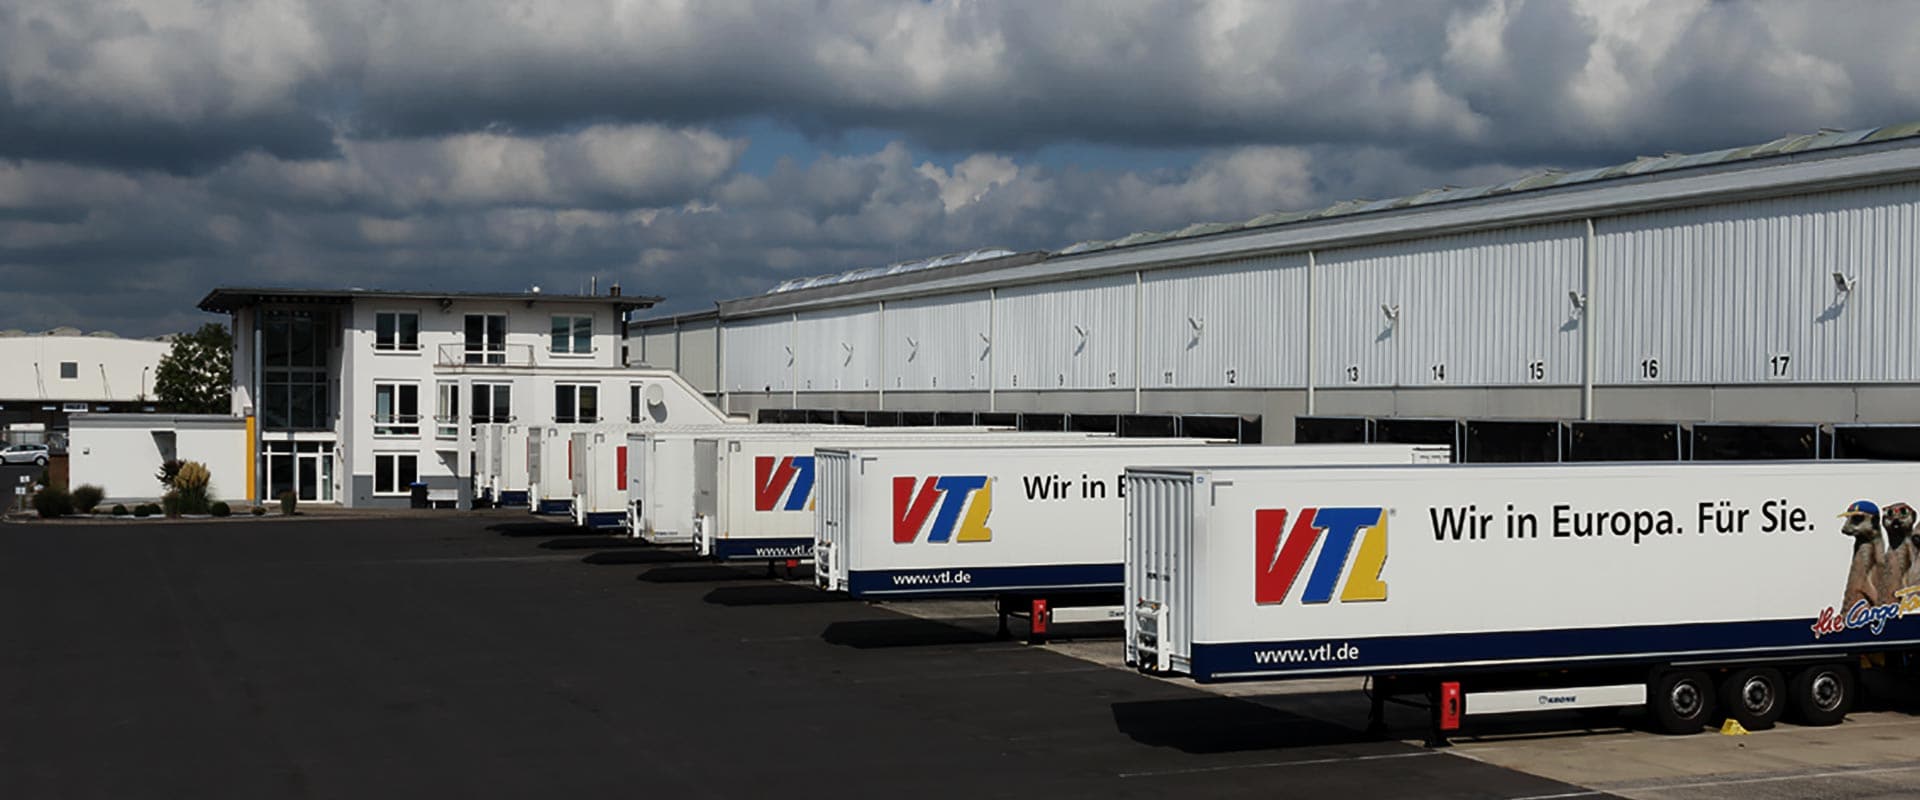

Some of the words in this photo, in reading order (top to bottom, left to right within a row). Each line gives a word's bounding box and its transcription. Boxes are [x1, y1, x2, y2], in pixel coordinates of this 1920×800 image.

[1347, 366, 1359, 382] 13
[1432, 364, 1445, 381] 14
[1529, 362, 1545, 380] 15
[1641, 359, 1659, 379] 16
[1770, 356, 1790, 376] 17
[1164, 372, 1173, 384] 11
[1226, 369, 1236, 384] 12
[755, 456, 816, 511] VT
[1023, 474, 1072, 500] Wir
[1082, 474, 1106, 499] in
[893, 476, 993, 543] VTL
[1429, 505, 1493, 541] Wir
[1507, 504, 1537, 539] in
[1553, 505, 1683, 544] Europa.
[1699, 500, 1750, 533] Für
[1761, 499, 1815, 533] Sie.
[1255, 507, 1388, 605] VTL
[893, 570, 971, 585] www.vtl.de
[1254, 642, 1360, 664] www.vtl.de
